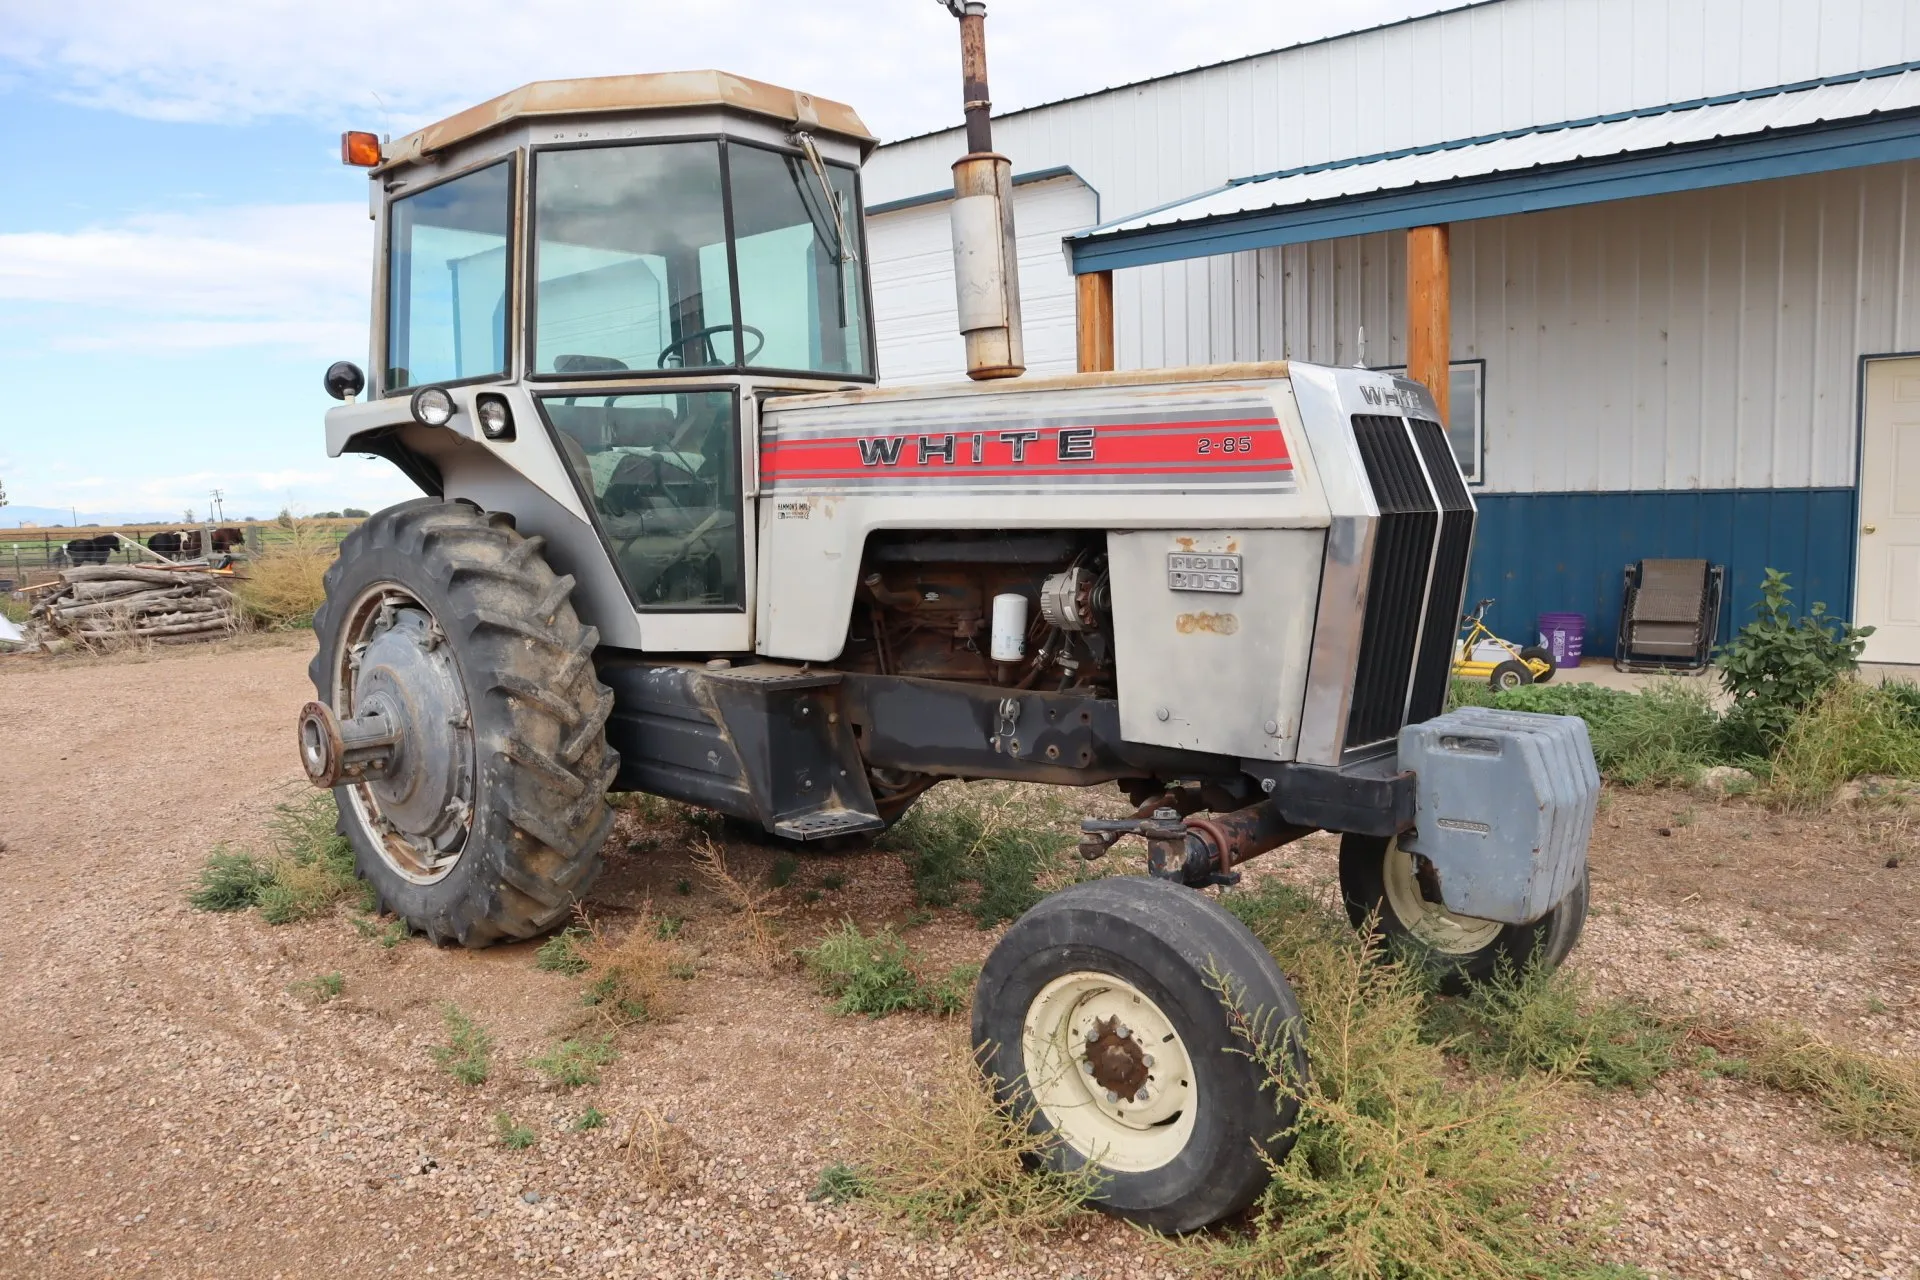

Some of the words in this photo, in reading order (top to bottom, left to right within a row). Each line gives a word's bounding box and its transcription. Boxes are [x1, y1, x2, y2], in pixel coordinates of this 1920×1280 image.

[857, 428, 1095, 466] WHITE
[1198, 436, 1252, 454] 2-85
[1171, 556, 1236, 571] FIELD
[1170, 572, 1237, 591] BOSS
